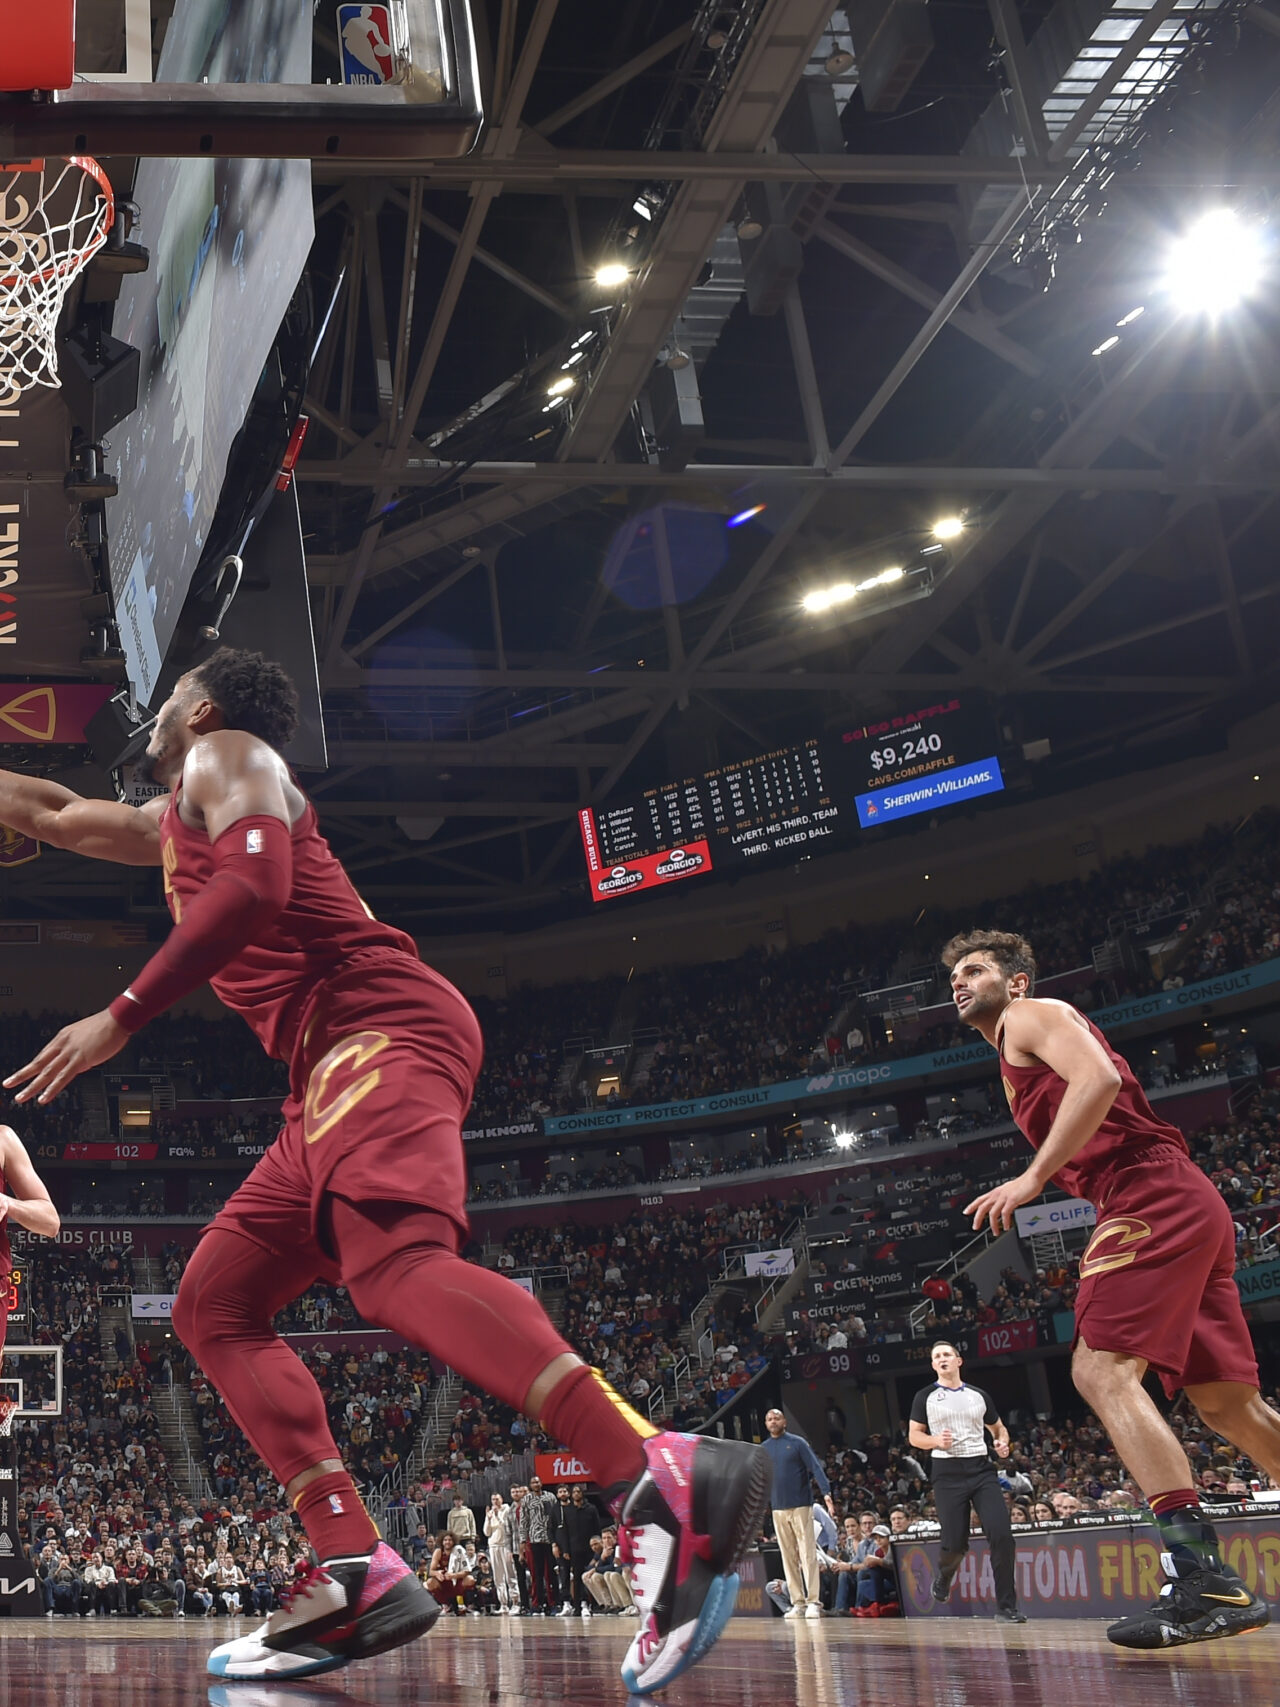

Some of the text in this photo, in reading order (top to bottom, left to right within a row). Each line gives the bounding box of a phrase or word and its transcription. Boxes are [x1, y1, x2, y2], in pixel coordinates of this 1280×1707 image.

[350, 73, 376, 85] NBA
[892, 699, 961, 728] RAFFLE
[870, 733, 942, 771] $9,240
[868, 755, 956, 788] CAVS.COM/RAFFLE
[135, 787, 169, 797] EASTER
[766, 823, 781, 835] HIS
[812, 807, 838, 821] TEAM
[581, 810, 598, 871] CHICAGO BULLS
[775, 832, 807, 848] KICKED
[656, 855, 703, 875] GEORGIO'S
[598, 872, 643, 891] GEORGIO'S
[1091, 973, 1252, 1025] PROTECT CONSULT
[838, 1064, 892, 1087] mcpc
[485, 1122, 539, 1138] KNOW.
[558, 1114, 622, 1131] CONNECT
[635, 1103, 696, 1121] PROTECT
[708, 1090, 770, 1110] CONSULT
[37, 1146, 57, 1158] 4Q
[114, 1145, 139, 1158] 102
[169, 1147, 195, 1157] FG%
[640, 1195, 664, 1206] M103
[17, 1231, 133, 1245] EGENDS CLUB
[814, 1277, 864, 1294] ROCKET
[1239, 1271, 1280, 1297] NAGE
[836, 1302, 866, 1313] Homes
[829, 1355, 850, 1372] 99
[866, 1354, 880, 1364] 4Q
[982, 1330, 1011, 1352] 102
[950, 1549, 1088, 1599] HATOM
